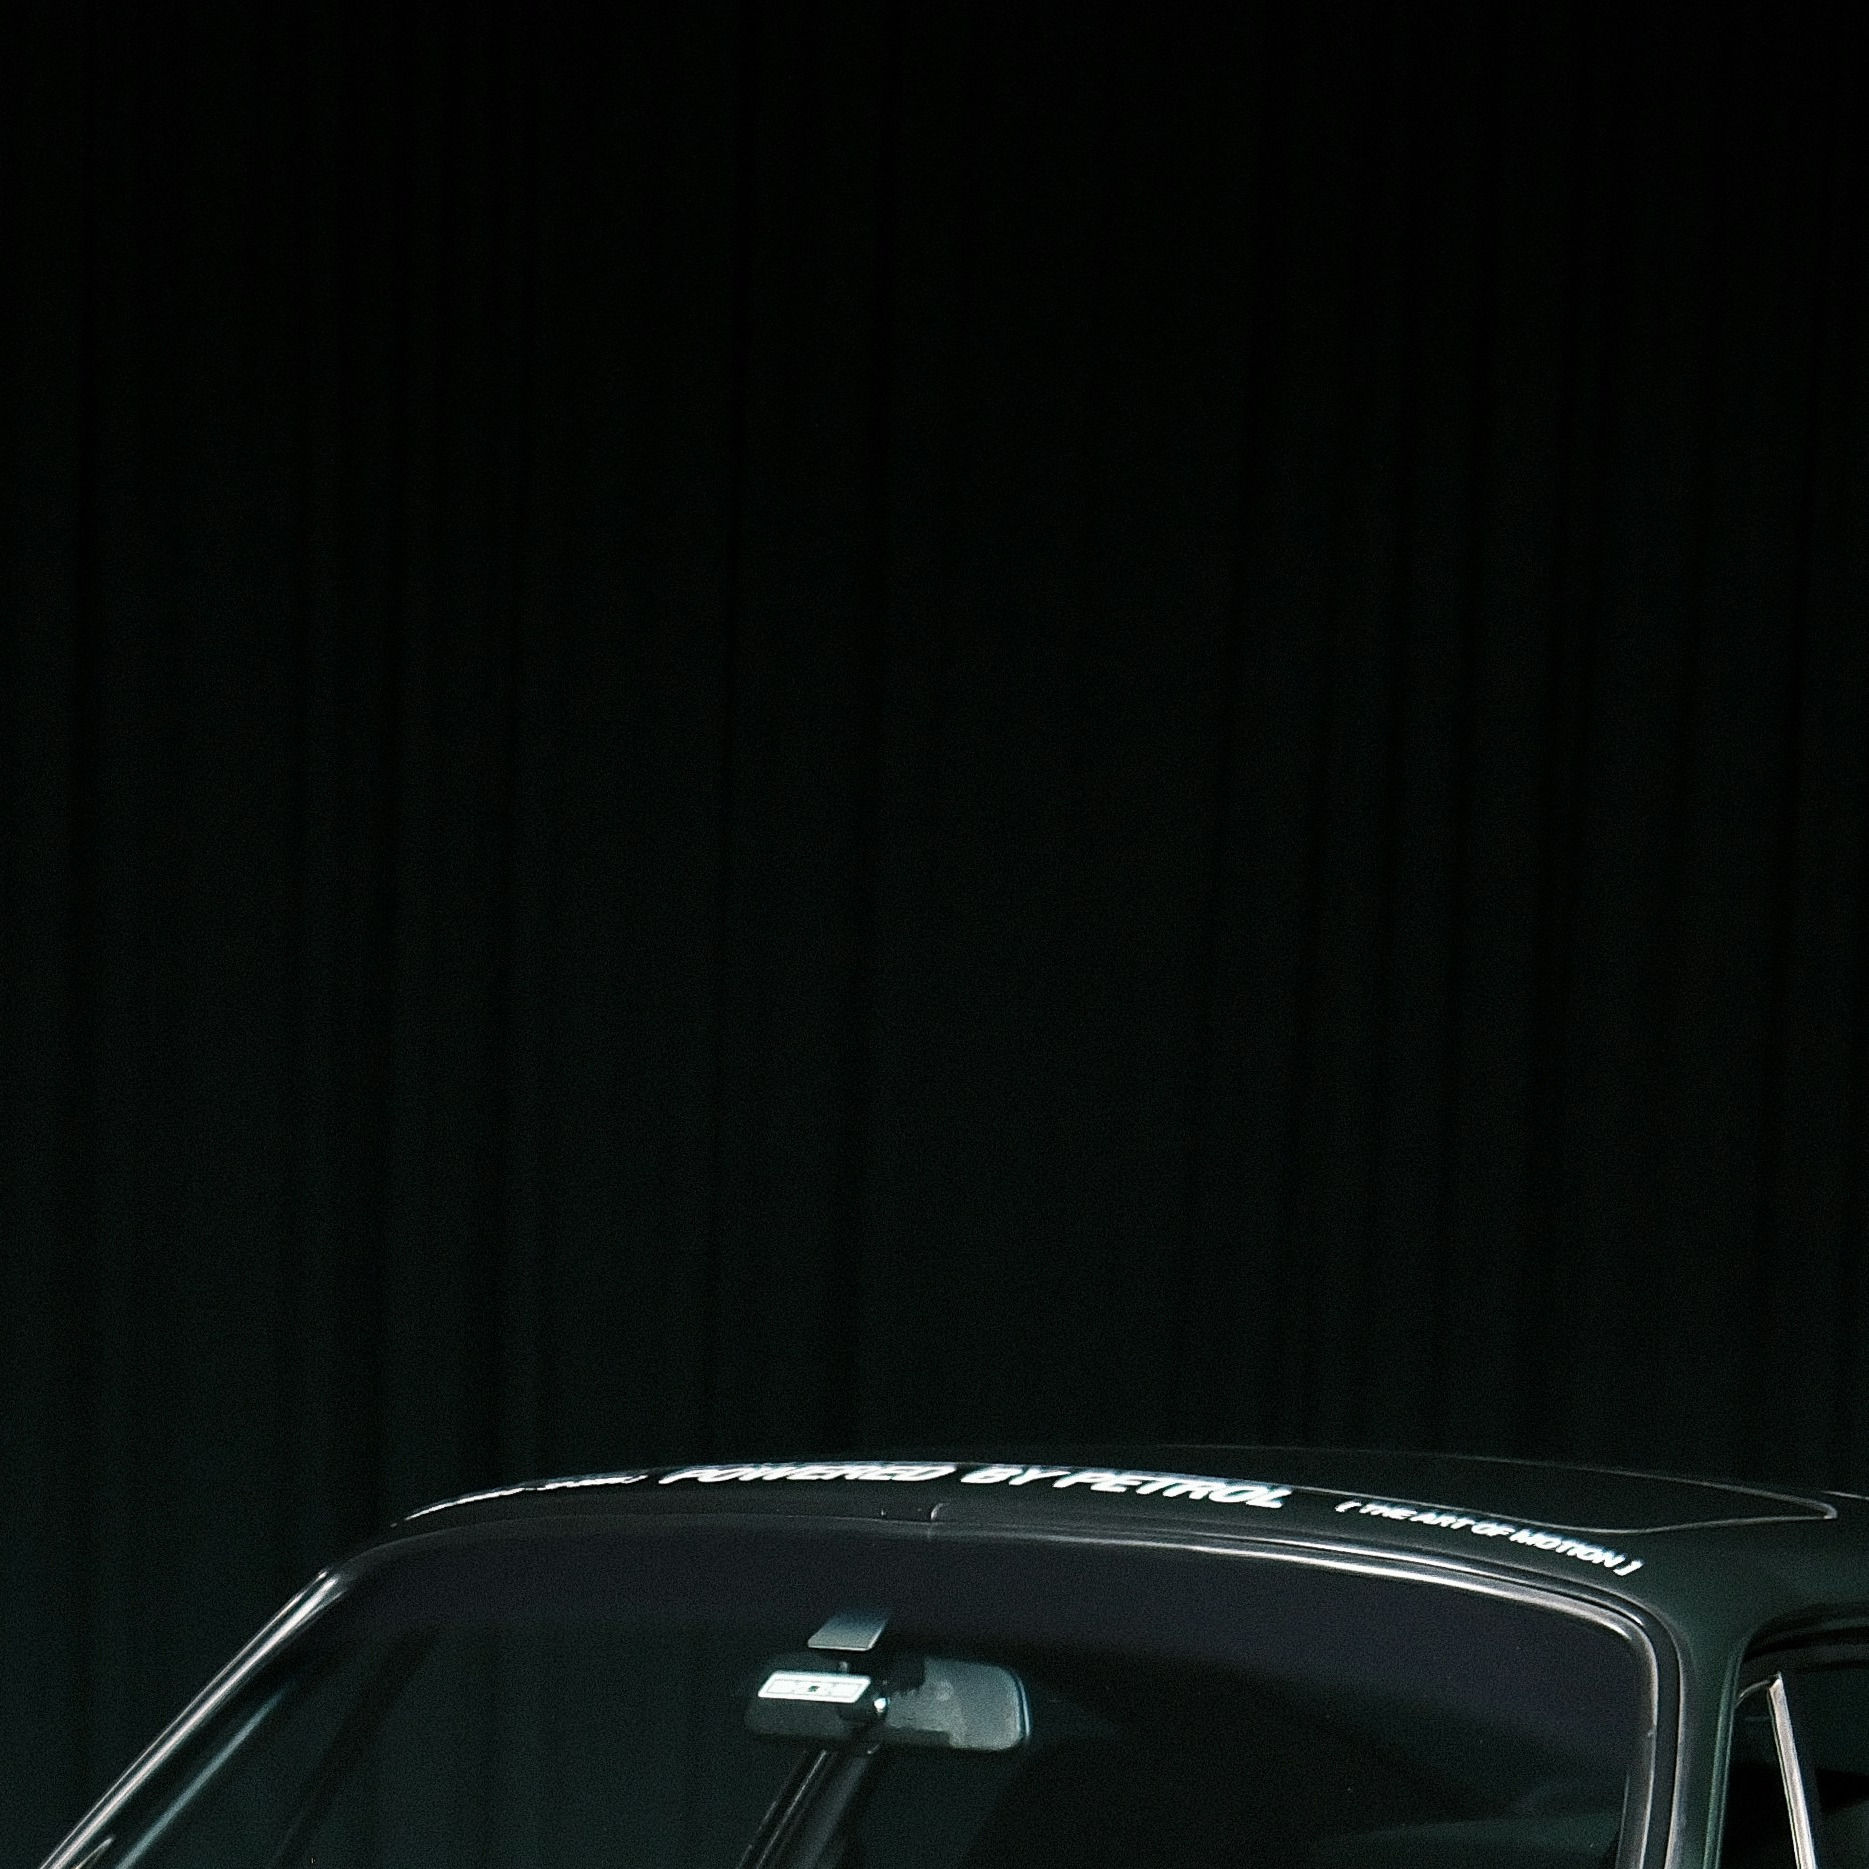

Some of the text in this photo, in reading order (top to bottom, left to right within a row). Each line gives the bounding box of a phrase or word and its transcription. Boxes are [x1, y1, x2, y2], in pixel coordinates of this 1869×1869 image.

[658, 1462, 1292, 1509] POWERED BY PETROL
[1358, 1503, 1418, 1520] THE
[1409, 1512, 1476, 1530] ART
[1471, 1521, 1516, 1537] OF
[1508, 1528, 1627, 1568] MOTION
